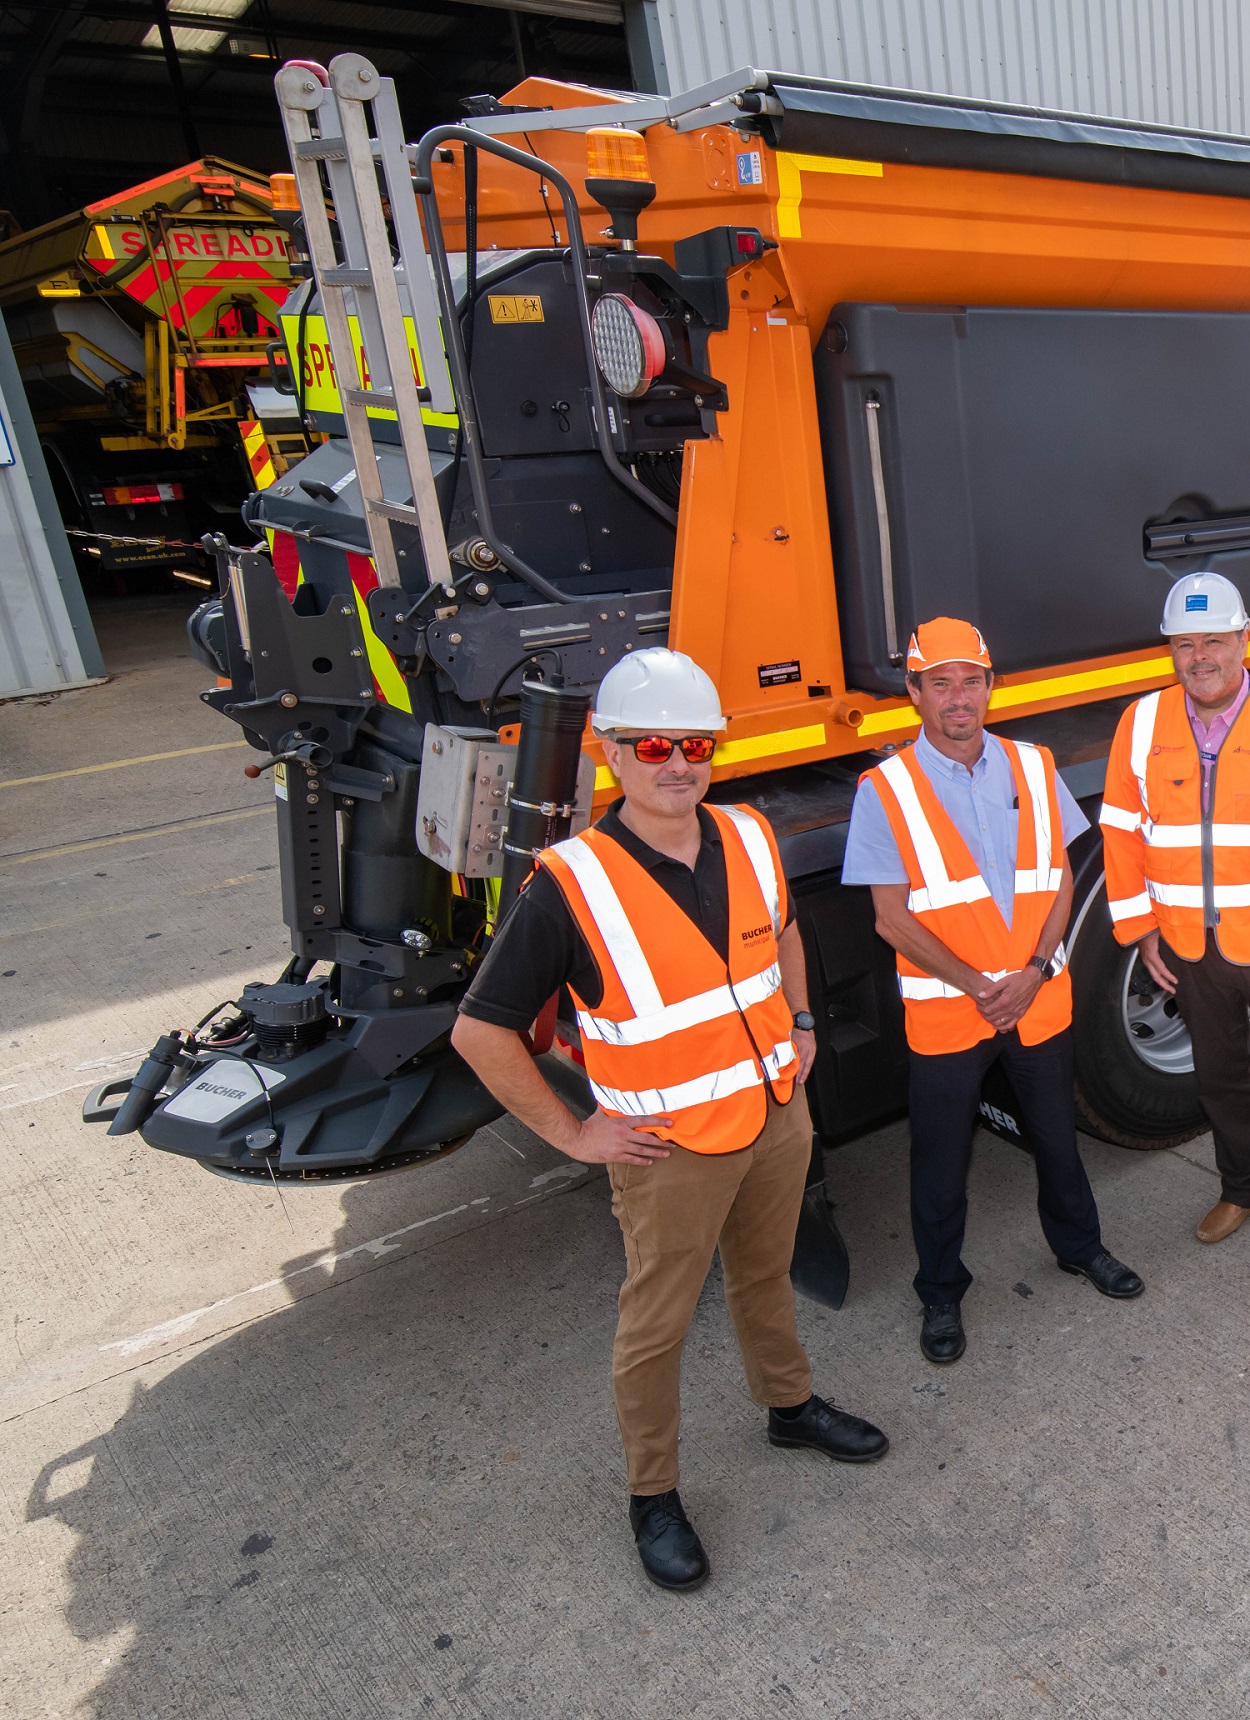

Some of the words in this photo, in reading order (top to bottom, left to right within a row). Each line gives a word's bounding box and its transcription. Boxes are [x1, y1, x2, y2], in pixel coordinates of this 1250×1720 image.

[115, 551, 186, 563] www.econ.uk.com
[741, 924, 773, 941] BUCHER
[195, 1082, 247, 1100] BUCHER
[979, 1101, 1021, 1136] HER
